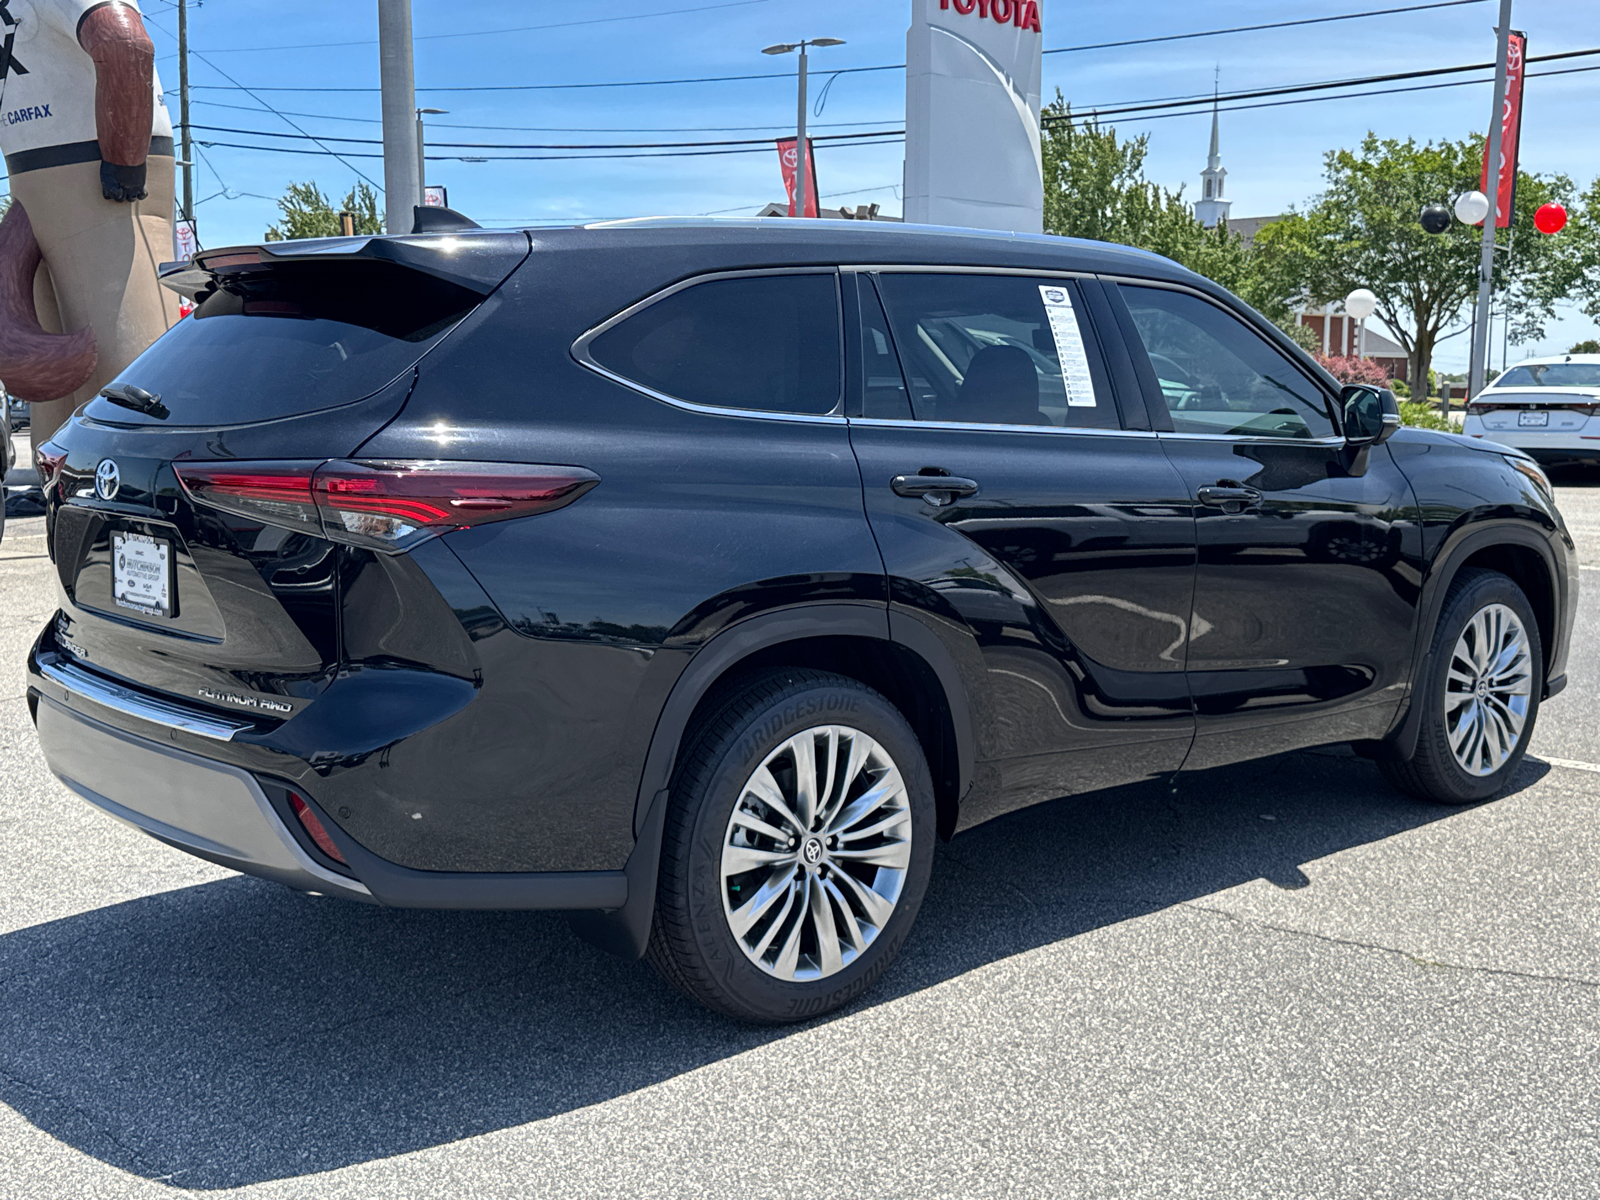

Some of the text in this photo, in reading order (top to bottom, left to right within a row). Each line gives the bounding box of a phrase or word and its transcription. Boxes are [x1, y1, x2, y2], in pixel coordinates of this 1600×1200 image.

[7, 103, 53, 125] CARFAX
[127, 557, 161, 574] HUTCHINSON
[198, 687, 293, 713] PLATINUM AWD
[737, 693, 861, 767] BRIDGESTONE
[692, 864, 723, 962] ALENZA
